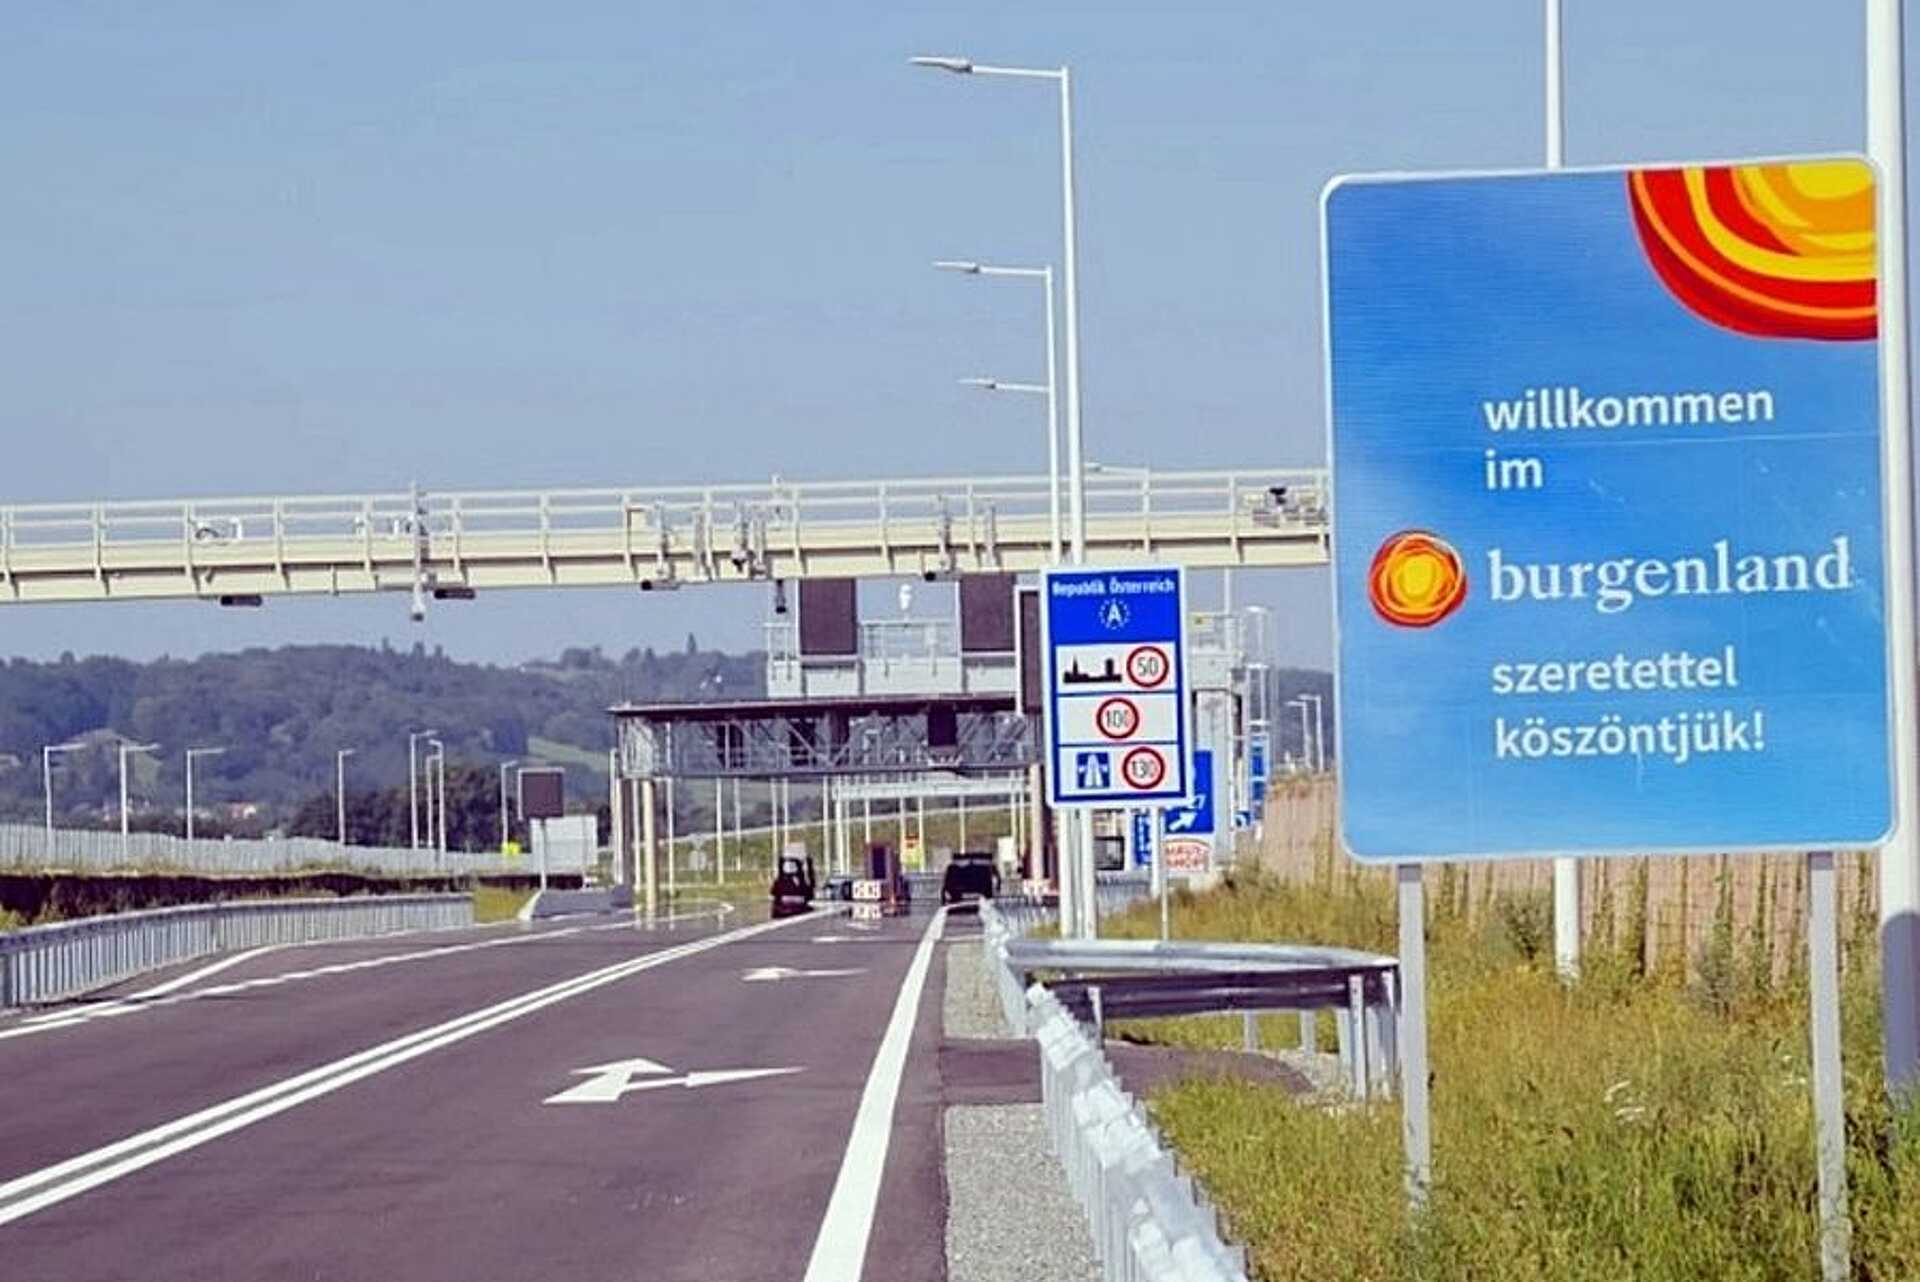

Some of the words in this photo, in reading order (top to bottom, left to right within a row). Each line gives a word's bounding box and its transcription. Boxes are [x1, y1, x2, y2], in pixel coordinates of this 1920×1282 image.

[1484, 388, 1774, 430] willkommen
[1486, 449, 1543, 488] im
[1052, 579, 1105, 597] Republik
[1109, 577, 1175, 594] Österreich
[1487, 536, 1852, 612] burgenland
[1136, 657, 1160, 677] 50
[1493, 646, 1737, 693] szeretettel
[1496, 712, 1763, 762] köszöntjük!
[1130, 758, 1158, 777] 130
